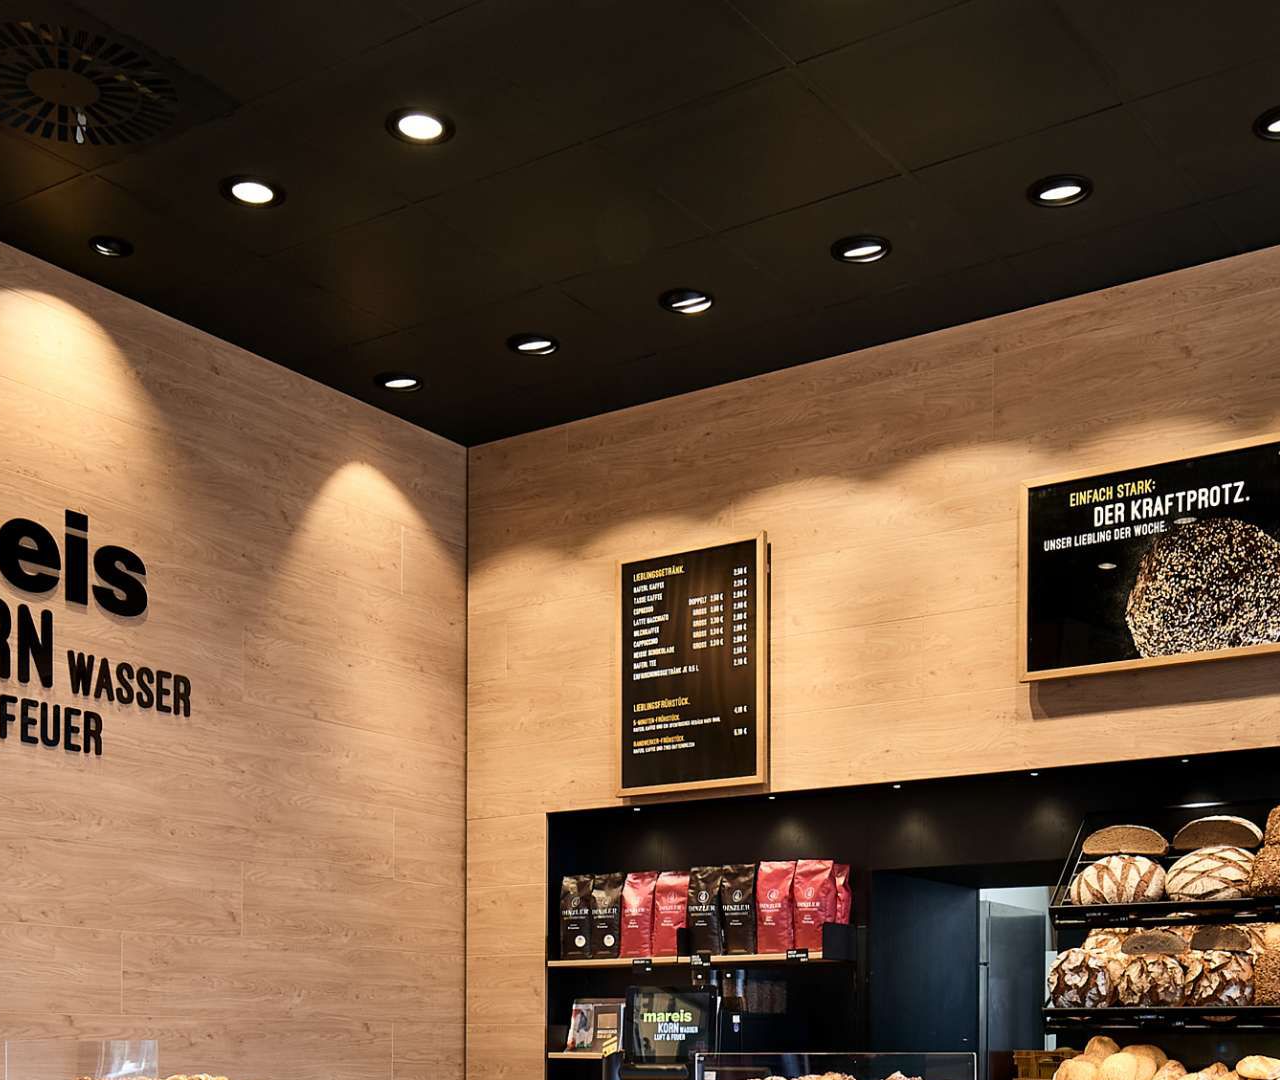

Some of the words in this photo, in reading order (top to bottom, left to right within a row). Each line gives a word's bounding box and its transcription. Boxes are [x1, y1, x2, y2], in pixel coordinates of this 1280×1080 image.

[1069, 483, 1113, 508] EINFACH
[1116, 479, 1156, 498] STARK:
[1093, 503, 1125, 527] DER
[1131, 481, 1251, 520] KRAFTPROTZ.
[1044, 537, 1072, 551] UNSER
[1074, 529, 1111, 547] LIEBLING
[1114, 526, 1131, 540] DER
[1134, 520, 1168, 537] WOCHE.
[67, 649, 191, 717] WASSER
[643, 1009, 693, 1023] mareis
[658, 1022, 679, 1034] KORN
